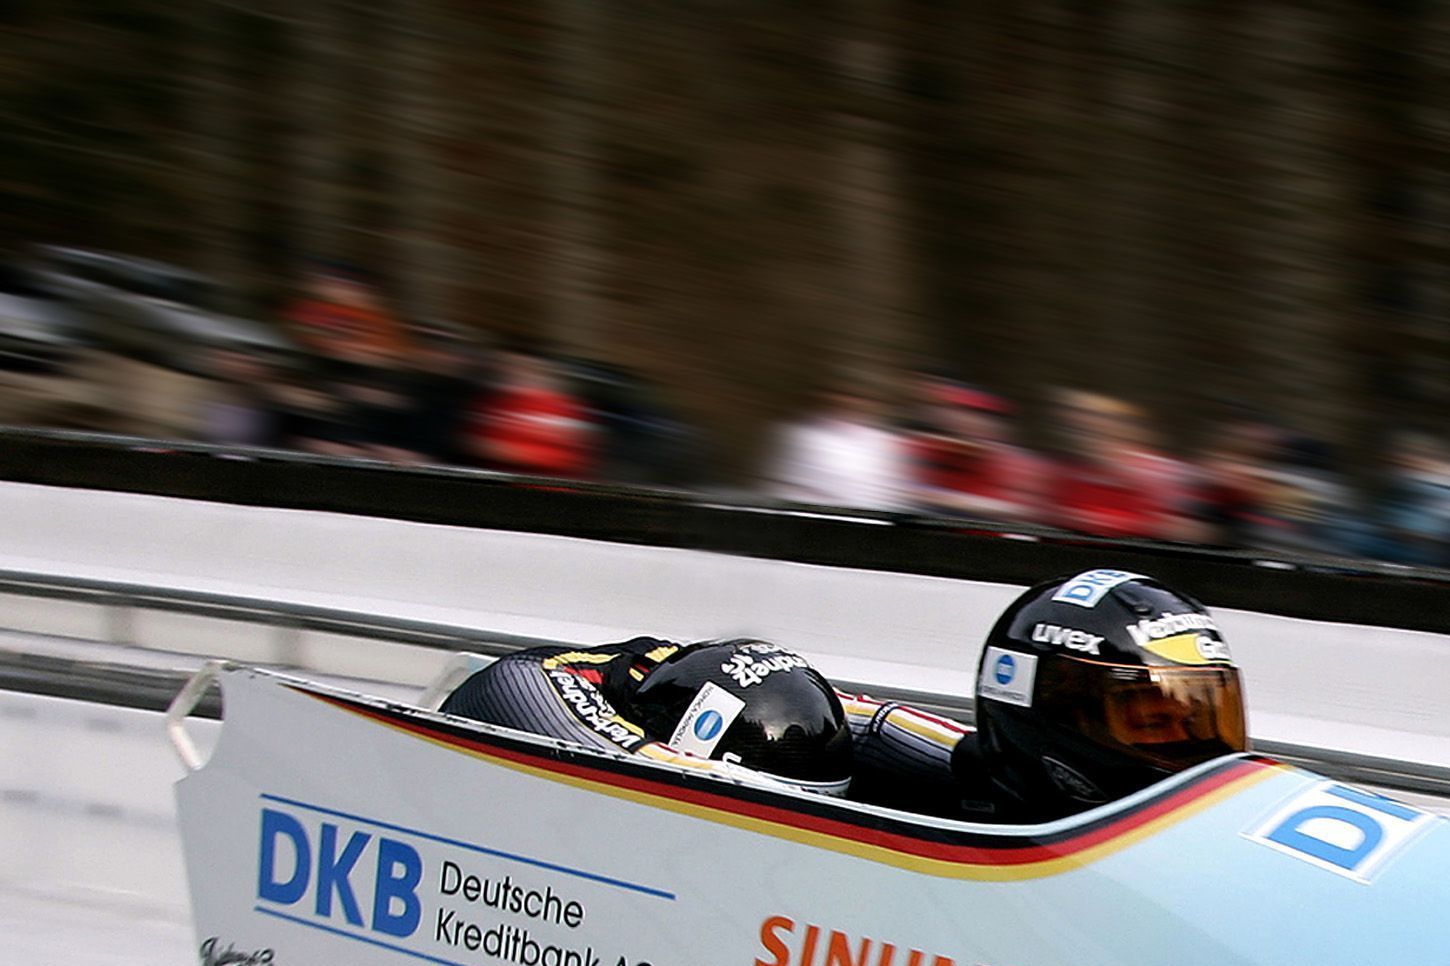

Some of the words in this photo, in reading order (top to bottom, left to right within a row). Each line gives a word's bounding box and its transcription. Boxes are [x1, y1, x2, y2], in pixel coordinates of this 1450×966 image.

[1032, 623, 1105, 656] uvex
[257, 808, 422, 939] DKB
[440, 860, 584, 929] Deutsche
